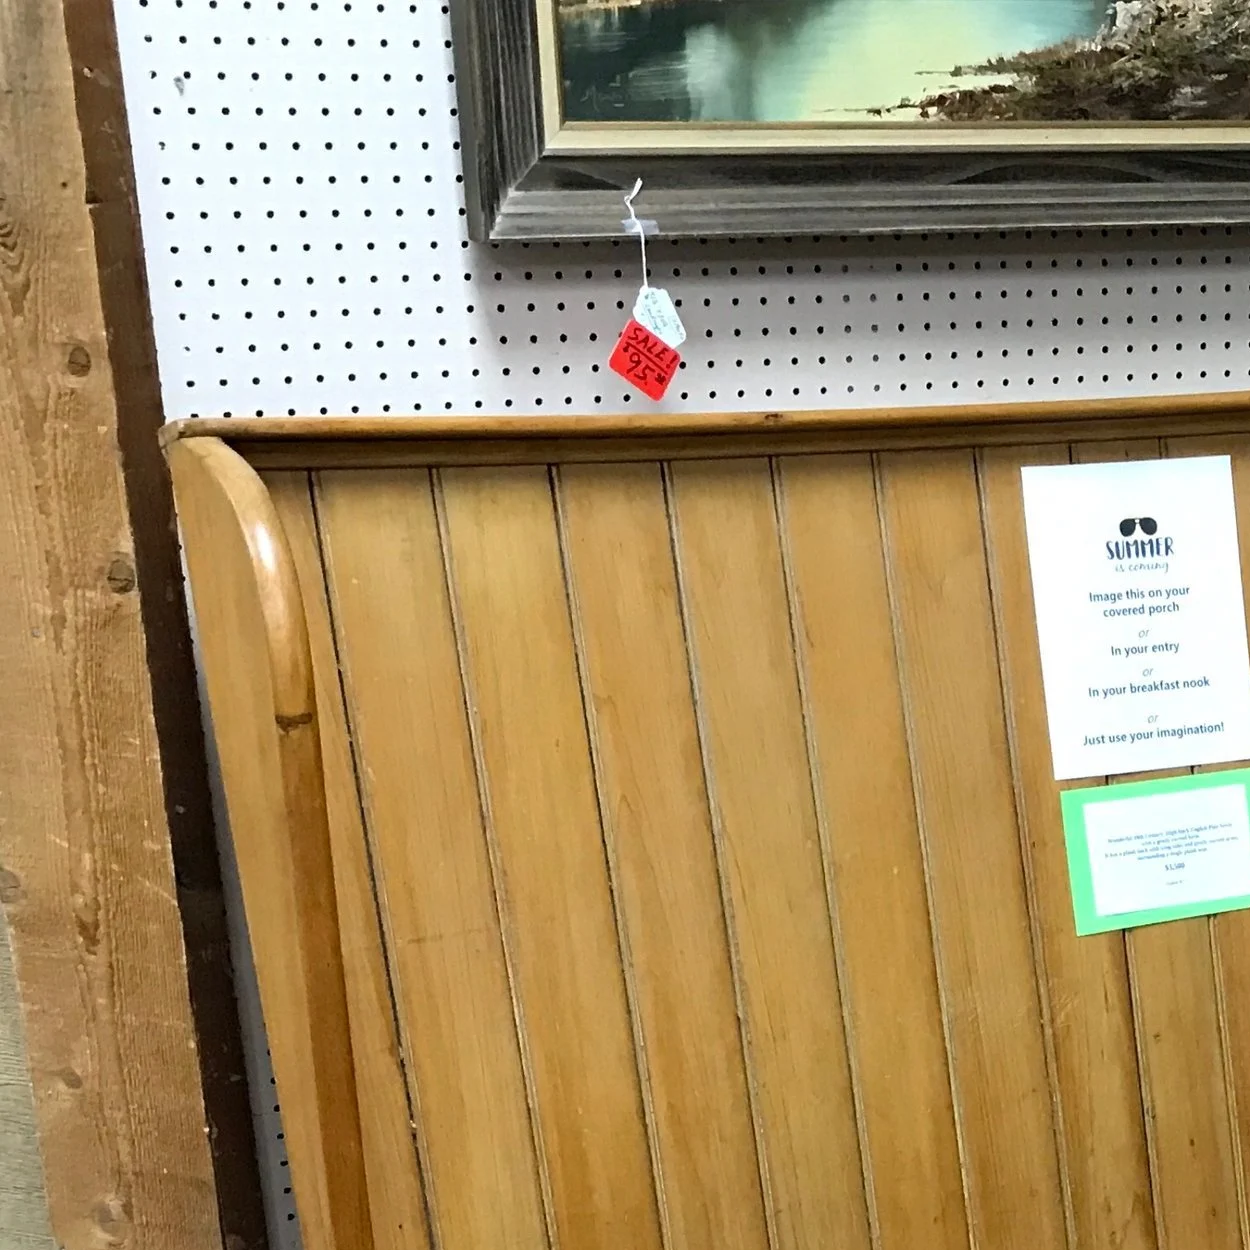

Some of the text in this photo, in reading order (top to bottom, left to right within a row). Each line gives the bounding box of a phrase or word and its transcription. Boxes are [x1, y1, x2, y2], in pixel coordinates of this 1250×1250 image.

[628, 327, 678, 369] SALE!
[1106, 536, 1174, 560] SUMMER
[1115, 562, 1169, 573] is coming
[1089, 587, 1190, 604] Image this on your
[1103, 602, 1180, 617] covered porch
[1138, 629, 1149, 638] or
[1111, 642, 1180, 658] In your entry
[1142, 668, 1153, 677] or
[1088, 676, 1210, 699] In your breakfast nook
[1147, 715, 1158, 724] or
[1083, 721, 1225, 746] Just use your imagination!
